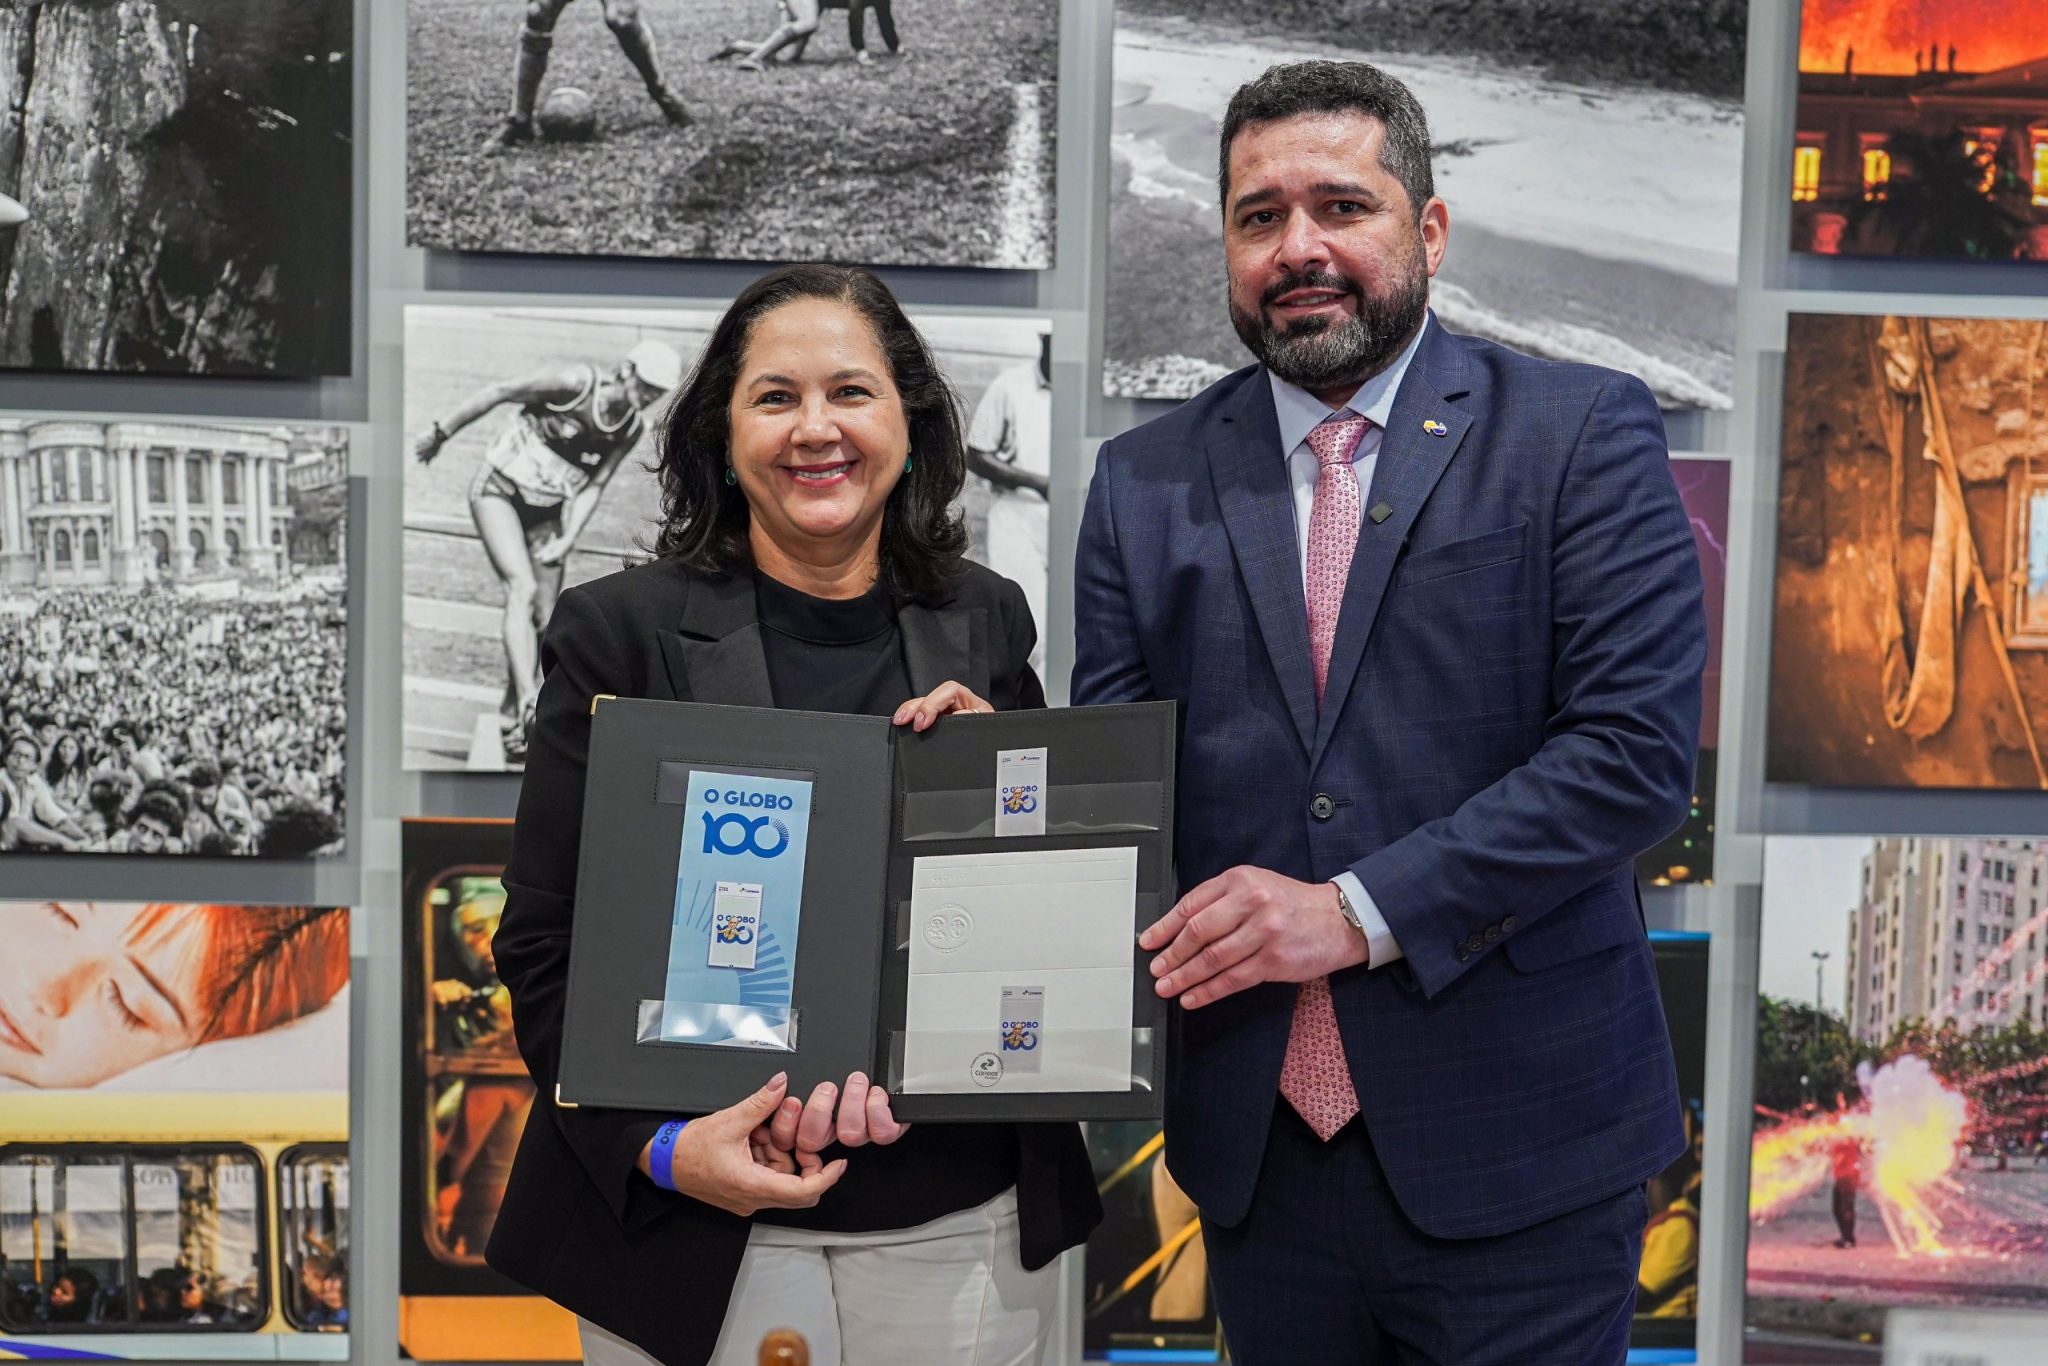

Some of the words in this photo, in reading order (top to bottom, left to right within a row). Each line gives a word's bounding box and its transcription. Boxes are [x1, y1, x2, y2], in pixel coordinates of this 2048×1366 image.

[1010, 785, 1038, 794] GOBO
[704, 788, 719, 803] O
[724, 790, 793, 811] GLOBO
[702, 811, 790, 858] 100
[725, 914, 756, 924] GOBO
[1002, 1021, 1009, 1029] O
[1010, 1021, 1039, 1029] GOBO
